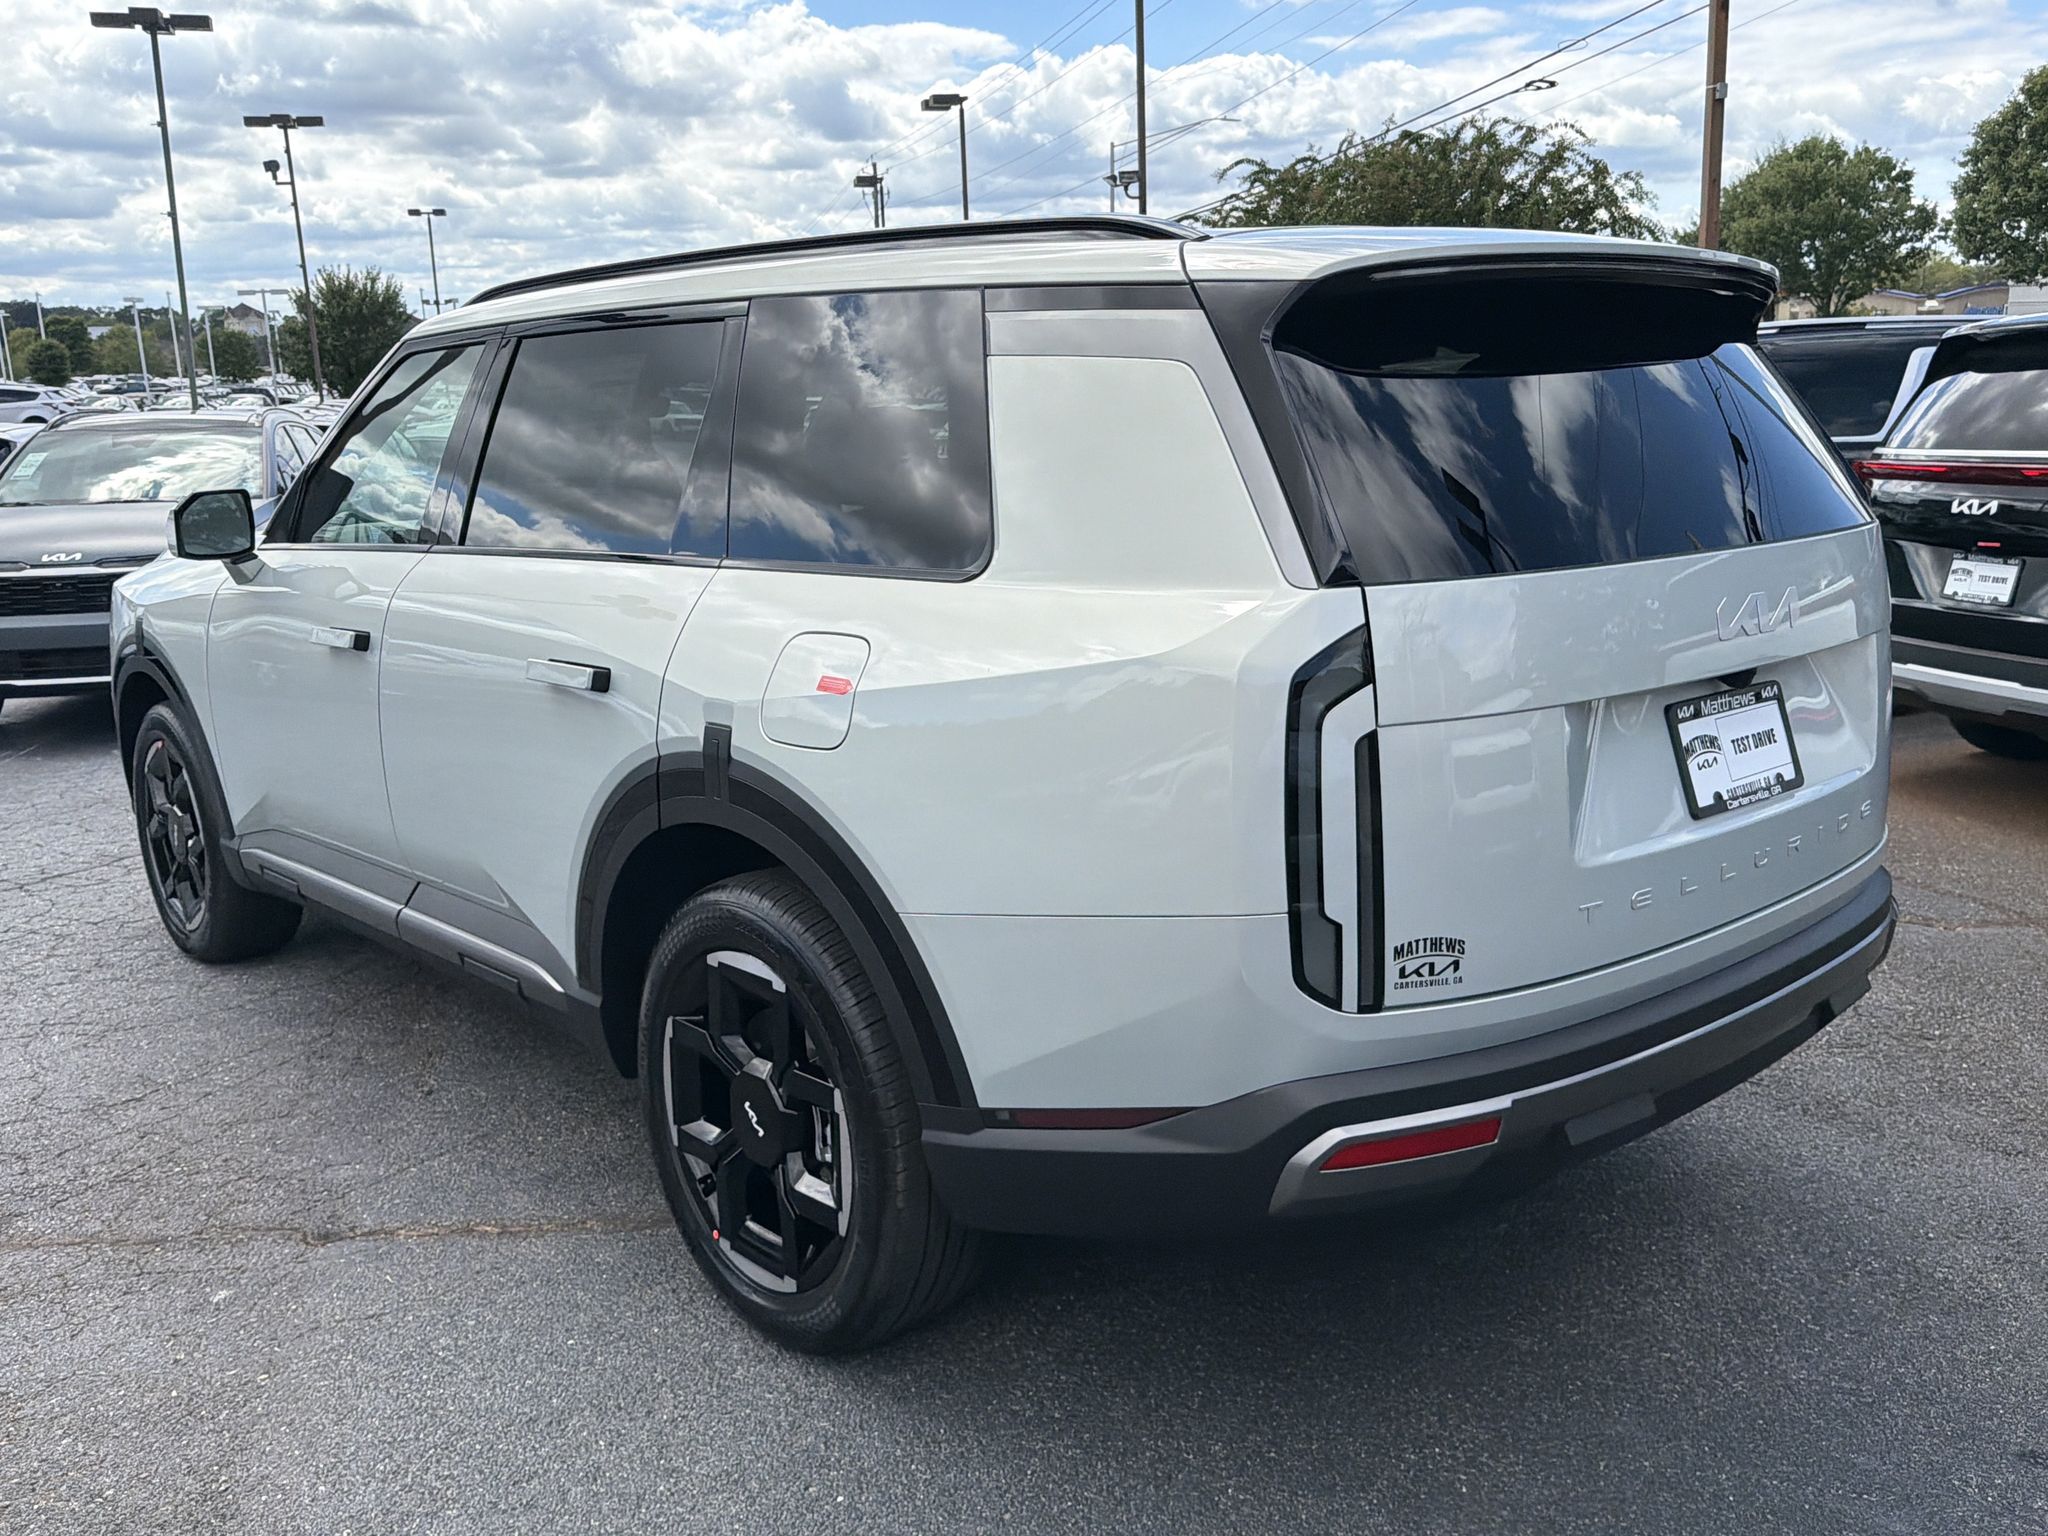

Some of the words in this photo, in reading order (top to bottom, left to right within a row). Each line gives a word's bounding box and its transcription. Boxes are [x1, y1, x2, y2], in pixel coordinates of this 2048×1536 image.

[1951, 499, 1998, 516] KIA
[1716, 586, 1799, 641] KIA
[1700, 692, 1756, 716] Matthews
[1731, 735, 1751, 755] TEST
[1752, 728, 1777, 750] DRIVE
[1770, 784, 1782, 795] GA
[1578, 800, 1871, 925] TELLURIDE
[1393, 936, 1466, 962] MATTHEWS
[1399, 959, 1460, 979] KIA
[1453, 976, 1463, 985] GA
